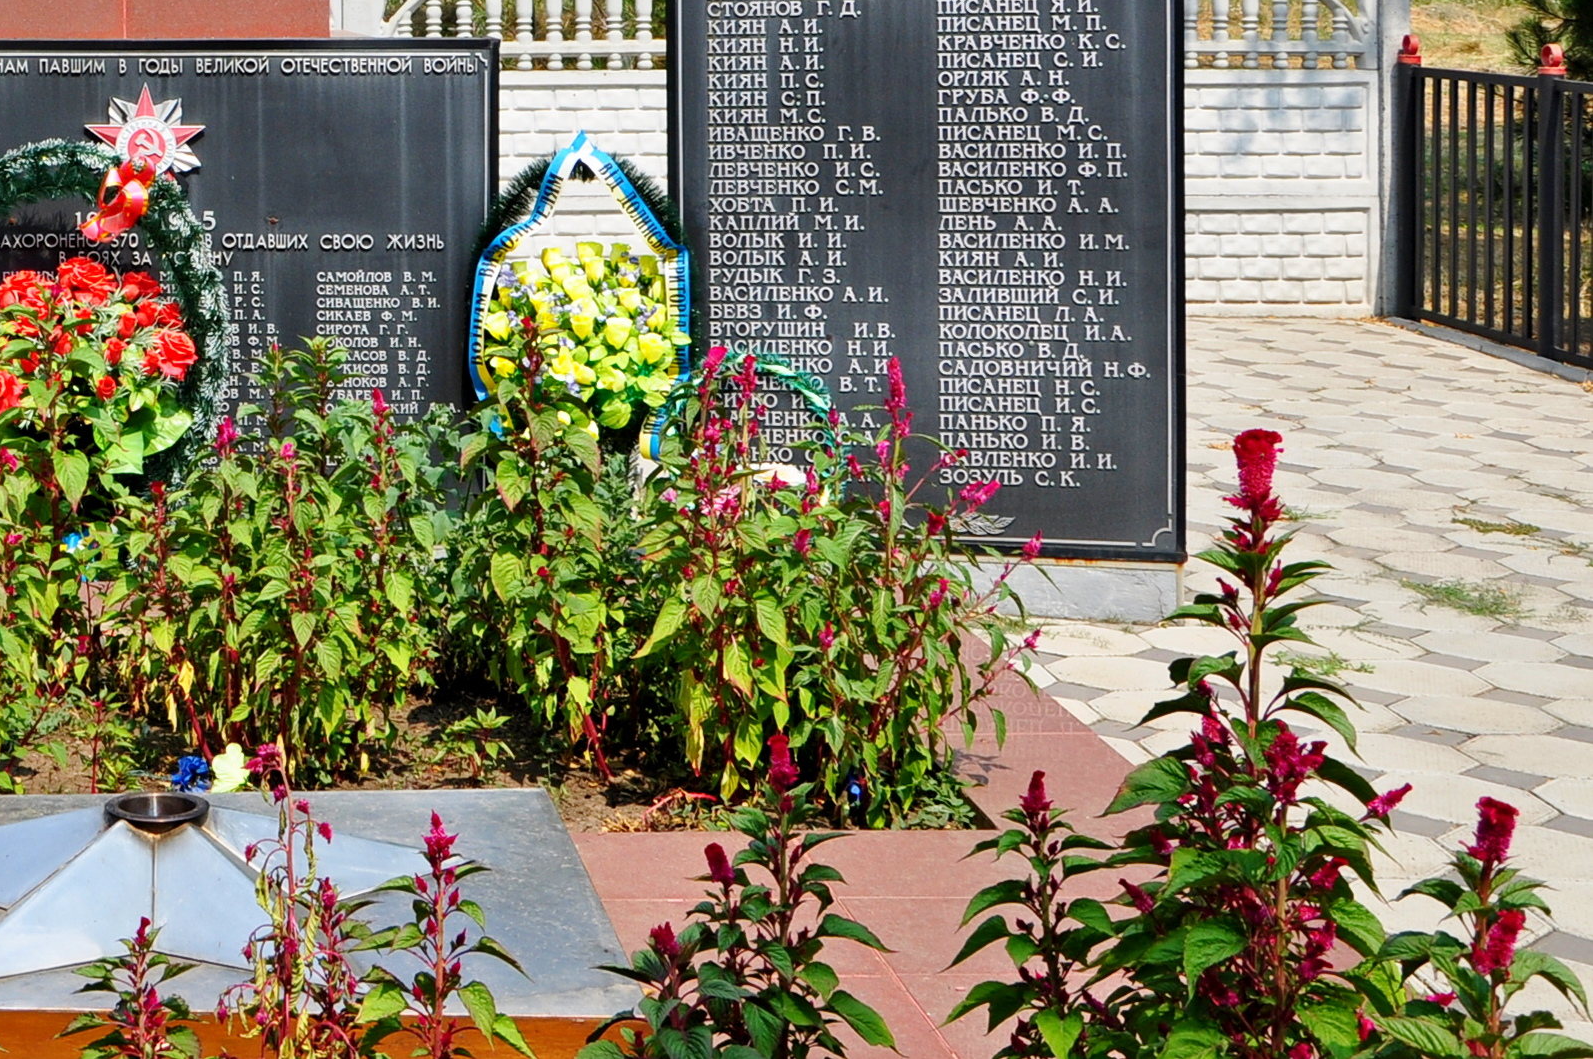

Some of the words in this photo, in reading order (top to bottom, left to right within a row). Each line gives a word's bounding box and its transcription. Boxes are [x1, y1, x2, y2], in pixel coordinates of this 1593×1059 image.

[706, 0, 803, 17] СТОЯНОВ
[706, 18, 767, 35] КИЯН
[936, 15, 1042, 33] ПИСАНЕЦ
[706, 36, 767, 53] КИЯН
[937, 33, 1067, 50] КРАВЧЕНКО
[38, 58, 106, 74] ПАВШИМ
[118, 58, 128, 74] В
[138, 58, 183, 75] ГОДЫ
[195, 56, 270, 74] ВЕЛИКОЙ
[280, 56, 413, 74] ОТЕЧЕСТВЕННОЙ
[423, 56, 479, 74] ВОЙНЫ
[707, 53, 769, 70] КИЯН
[937, 51, 1042, 69] ПИСАНЕЦ
[706, 71, 769, 88] КИЯН
[937, 70, 1010, 87] ОРЛЯК
[707, 89, 768, 106] КИЯН
[937, 88, 1010, 105] ГРУБА
[707, 107, 768, 124] КИЯН
[937, 106, 1029, 123] ПАЛЬКО
[707, 125, 825, 143] ИВАЩЕНКО
[937, 124, 1042, 142] ПИСАНЕЦ
[707, 143, 806, 160] ИВЧЕНКО
[937, 142, 1067, 159] ВАСИЛЕНКО
[708, 160, 820, 178] ЛЕВЧЕНКО
[937, 160, 1067, 177] ВАСИЛЕНКО
[708, 178, 820, 195] ЛЕВЧЕНКО
[937, 178, 1023, 195] ПАСЬКО
[708, 196, 777, 213] ХОБТА
[938, 196, 1057, 213] ШЕВЧЕНКО
[709, 211, 800, 231] КАПЛИЙ
[938, 214, 997, 231] ЛЕНЬ
[222, 233, 308, 250] ОТДАВШИХ
[319, 234, 375, 251] СВОЮ
[386, 234, 445, 251] ЖИЗНЬ
[708, 232, 785, 249] ВОЛЫК
[938, 233, 1066, 250] ВАСИЛЕНКО
[131, 250, 153, 266] ЗА
[709, 250, 786, 267] ВОЛЫК
[938, 251, 1001, 268] КИЯН
[316, 269, 393, 283] САМОЙЛОВ
[709, 268, 784, 286] РУДЫК
[938, 269, 1066, 286] ВАСИЛЕНКО
[316, 284, 390, 296] СЕМЕНОВА
[709, 285, 835, 302] ВАСИЛЕНКО
[937, 284, 1060, 304] ЗАЛИВШИЙ
[316, 297, 401, 309] СИВАЩЕНКО
[709, 303, 763, 320] БЕВЗ
[316, 310, 372, 322] СИКАЕВ
[938, 305, 1041, 323] ПИСАНЕЦ
[316, 324, 370, 336] СИРОТА
[709, 321, 826, 338] ВТОРУШИН
[938, 323, 1069, 341] КОЛОКОЛЕЦ
[324, 337, 379, 349] ОКОЛОВ
[938, 341, 1025, 358] ПАСЬКО
[938, 356, 1093, 377] САДОВНИЧИЙ
[939, 377, 1041, 395] ПИСАНЕЦ
[939, 396, 1041, 414] ПИСАНЕЦ
[938, 414, 1028, 431] ПАНЬКО
[938, 432, 1029, 449] ПАНЬКО
[939, 468, 1024, 485] ЗОЗУЛЬ
